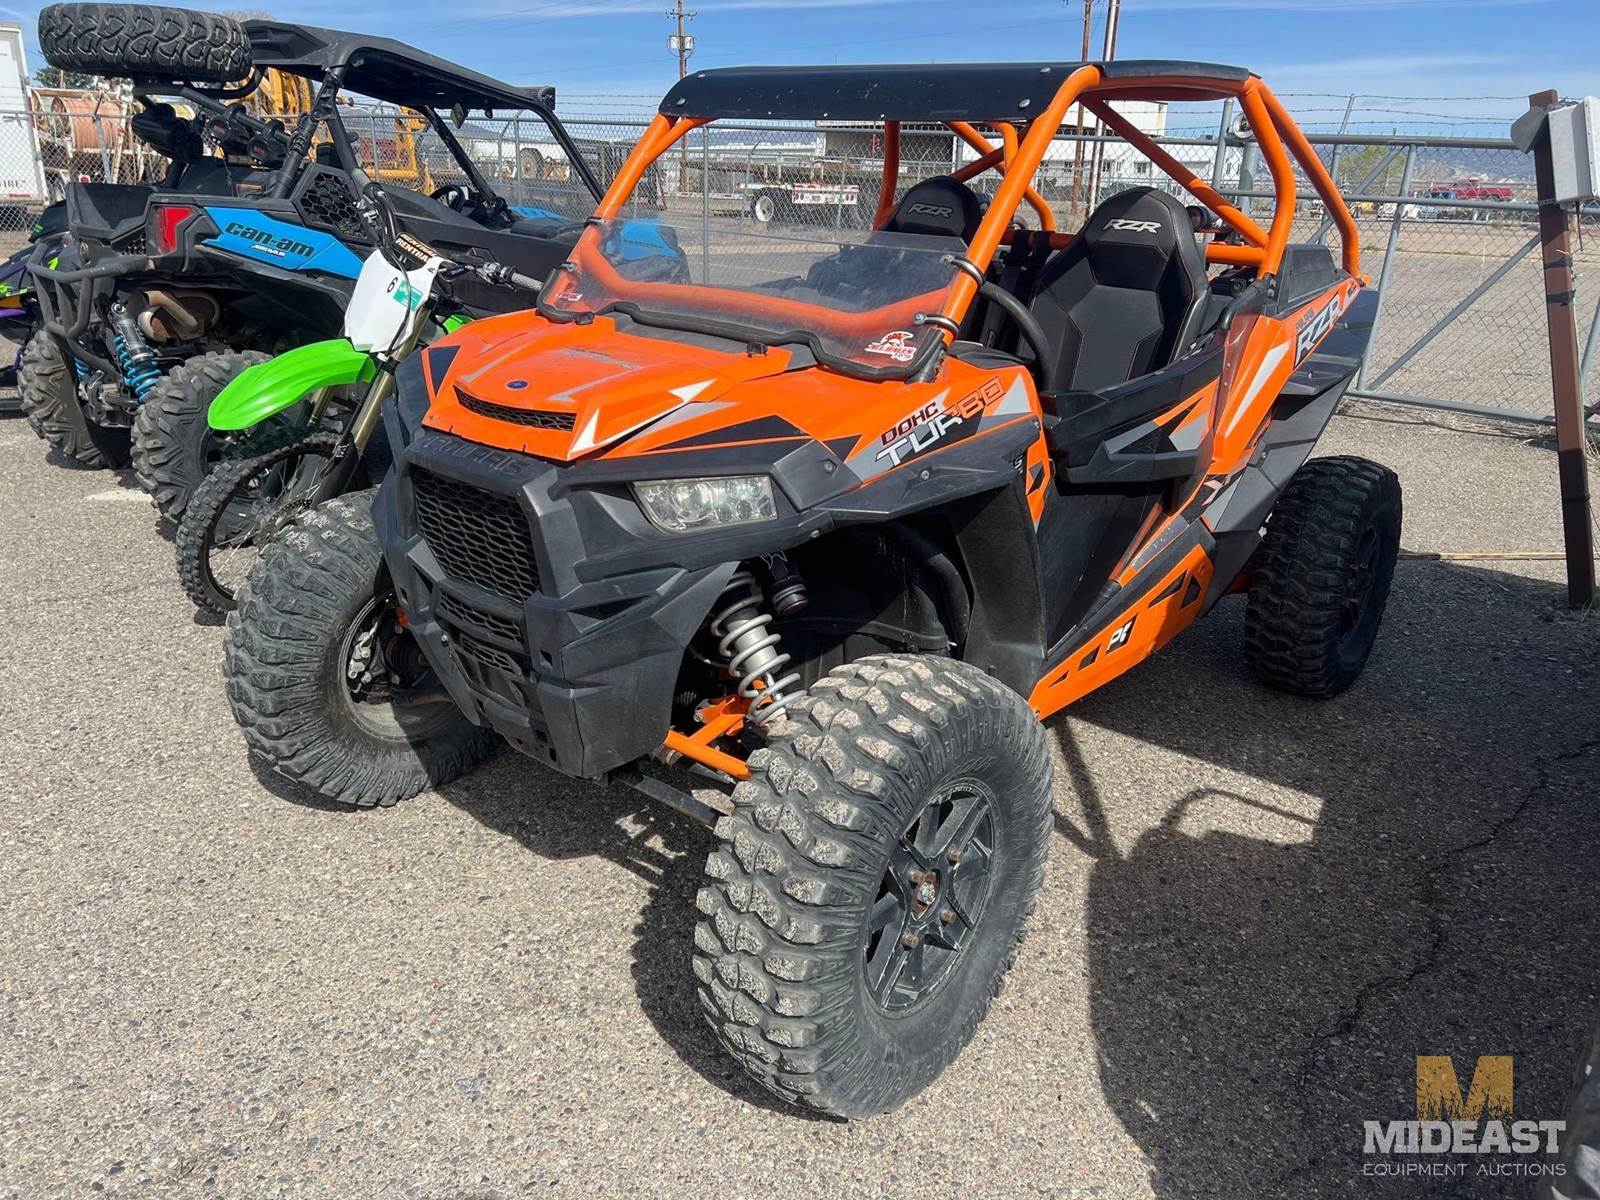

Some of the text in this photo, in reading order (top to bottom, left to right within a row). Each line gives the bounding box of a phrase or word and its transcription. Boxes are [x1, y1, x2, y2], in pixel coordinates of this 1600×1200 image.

[908, 203, 953, 218] RZR
[1103, 219, 1162, 234] RZR
[224, 221, 316, 257] can-am
[395, 237, 430, 262] RENTHA
[1295, 294, 1345, 366] RZR
[874, 376, 1006, 467] TURBO
[880, 401, 939, 446] DOHC
